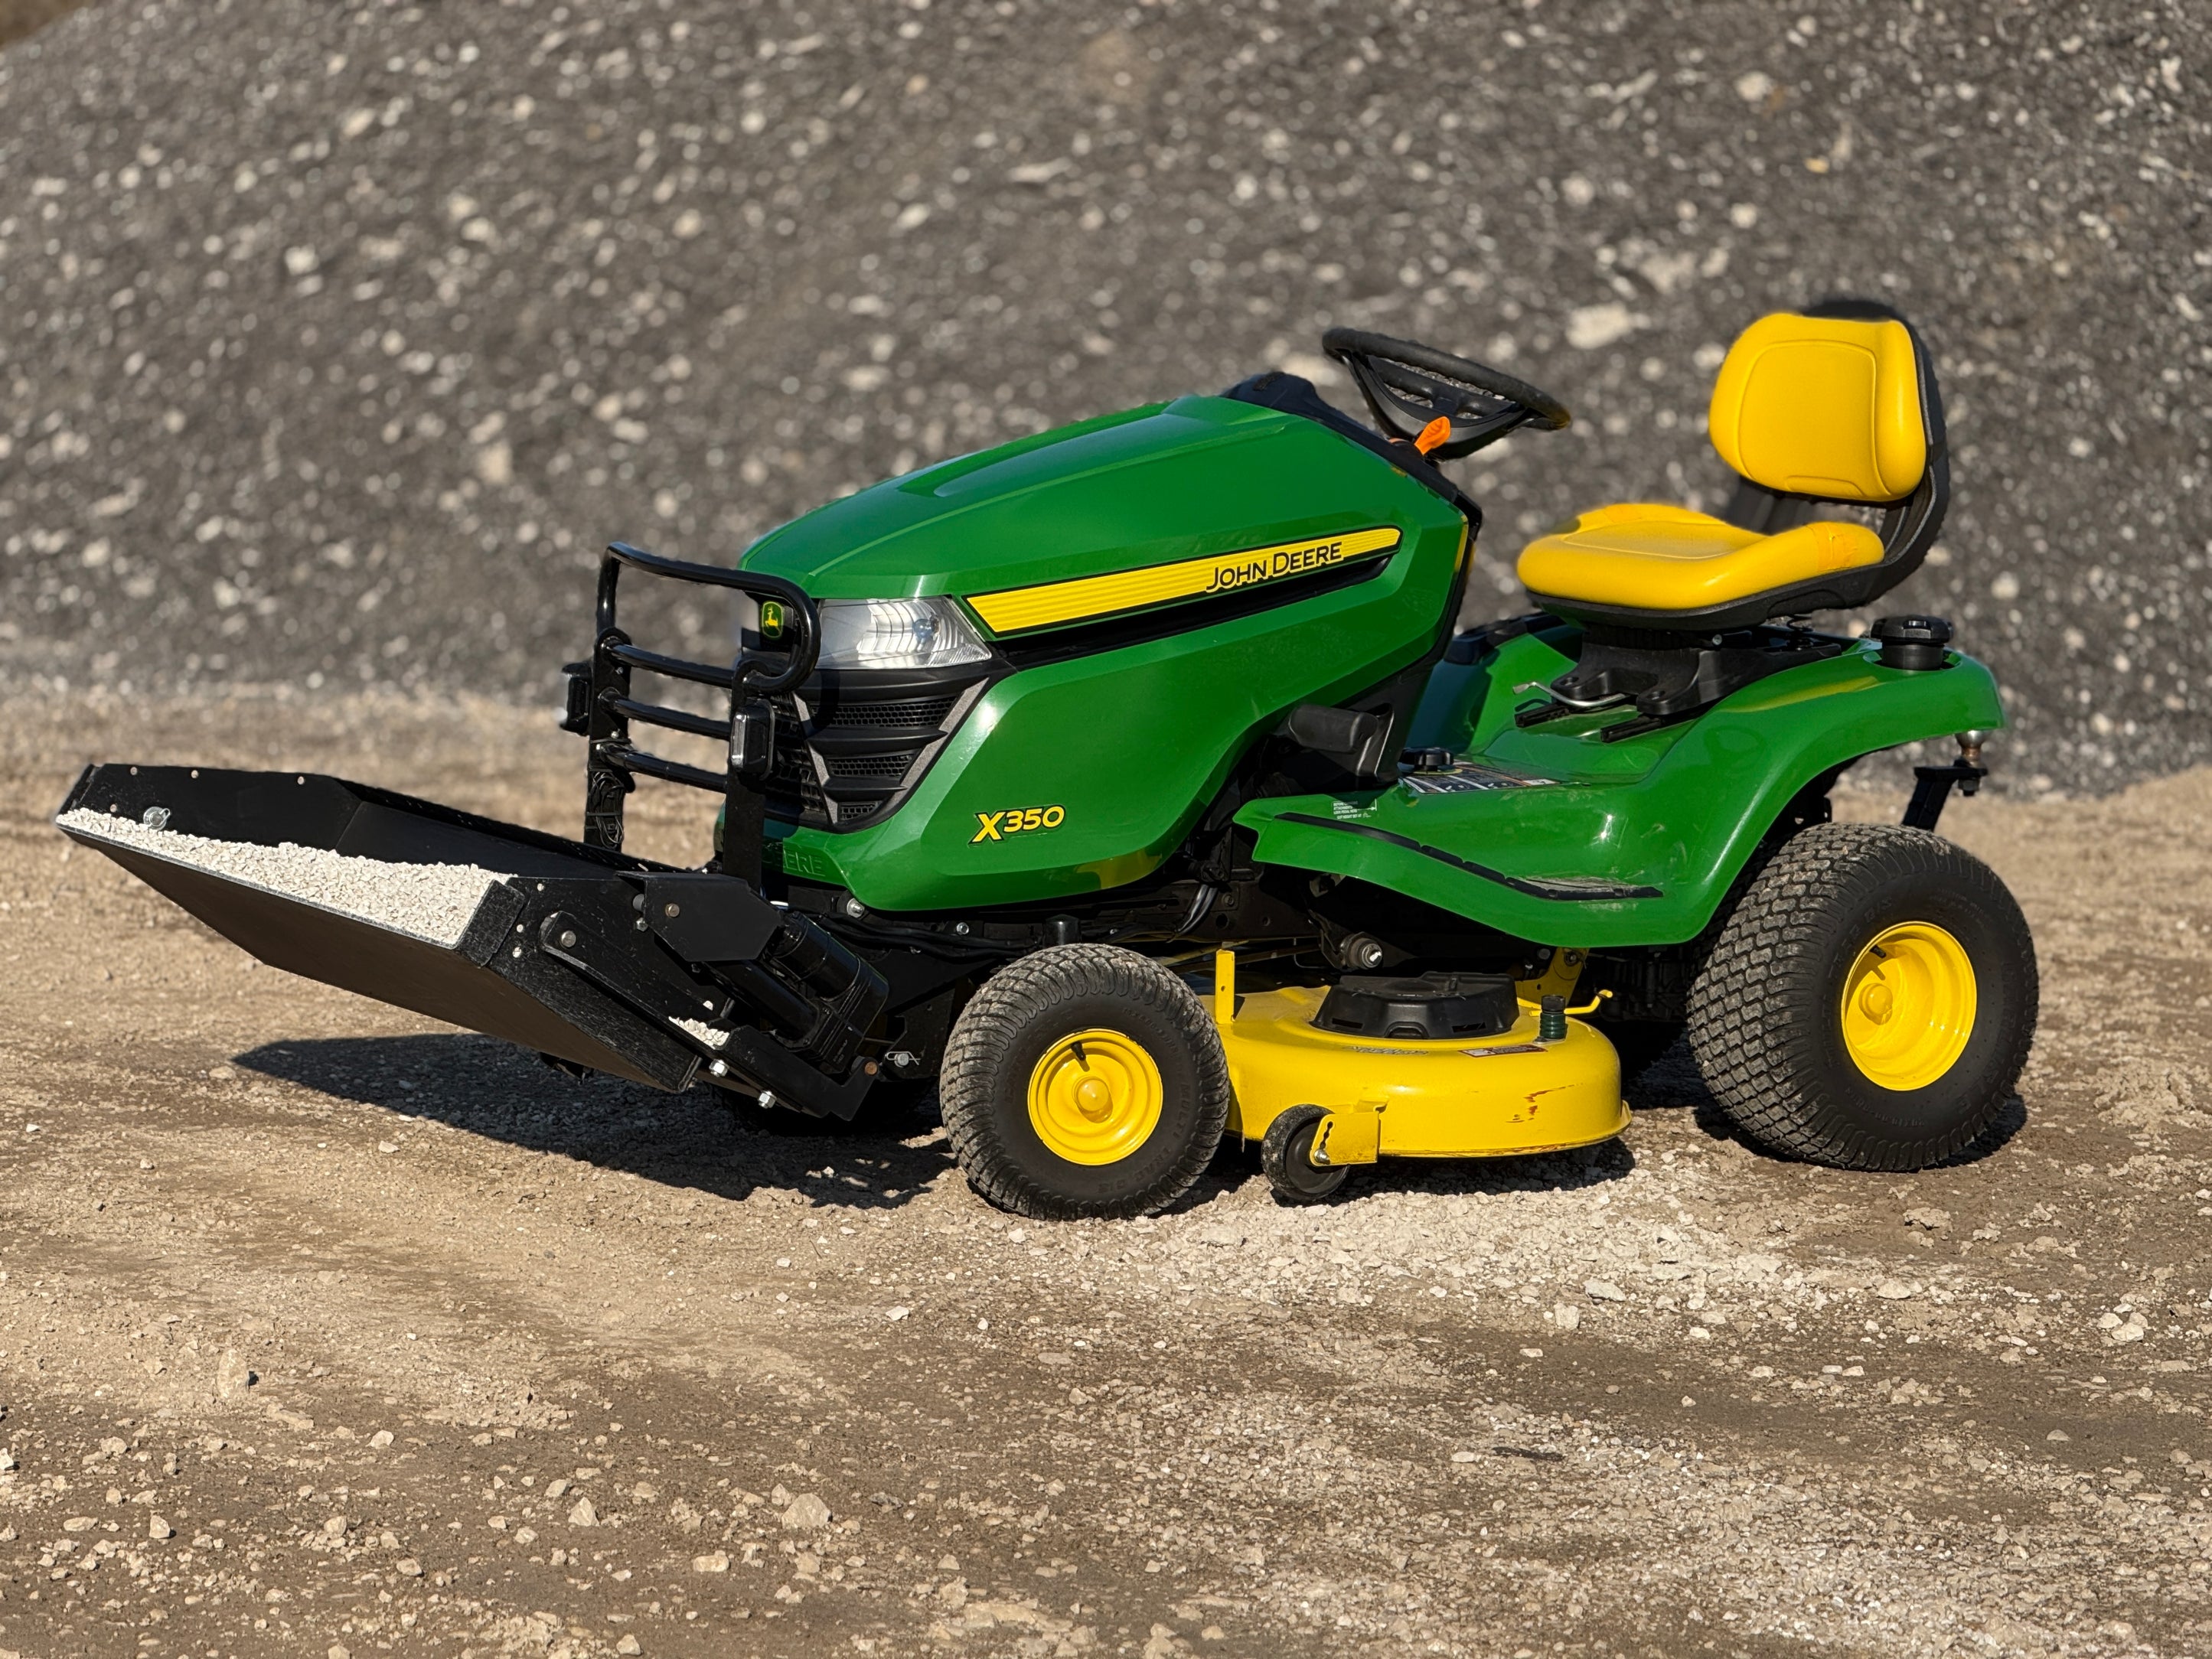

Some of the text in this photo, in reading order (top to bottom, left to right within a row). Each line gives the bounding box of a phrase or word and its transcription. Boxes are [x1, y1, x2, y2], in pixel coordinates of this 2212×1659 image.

[1206, 541, 1343, 592] JOHN DEERE
[969, 804, 1065, 844] X350
[770, 848, 826, 877] ERE
